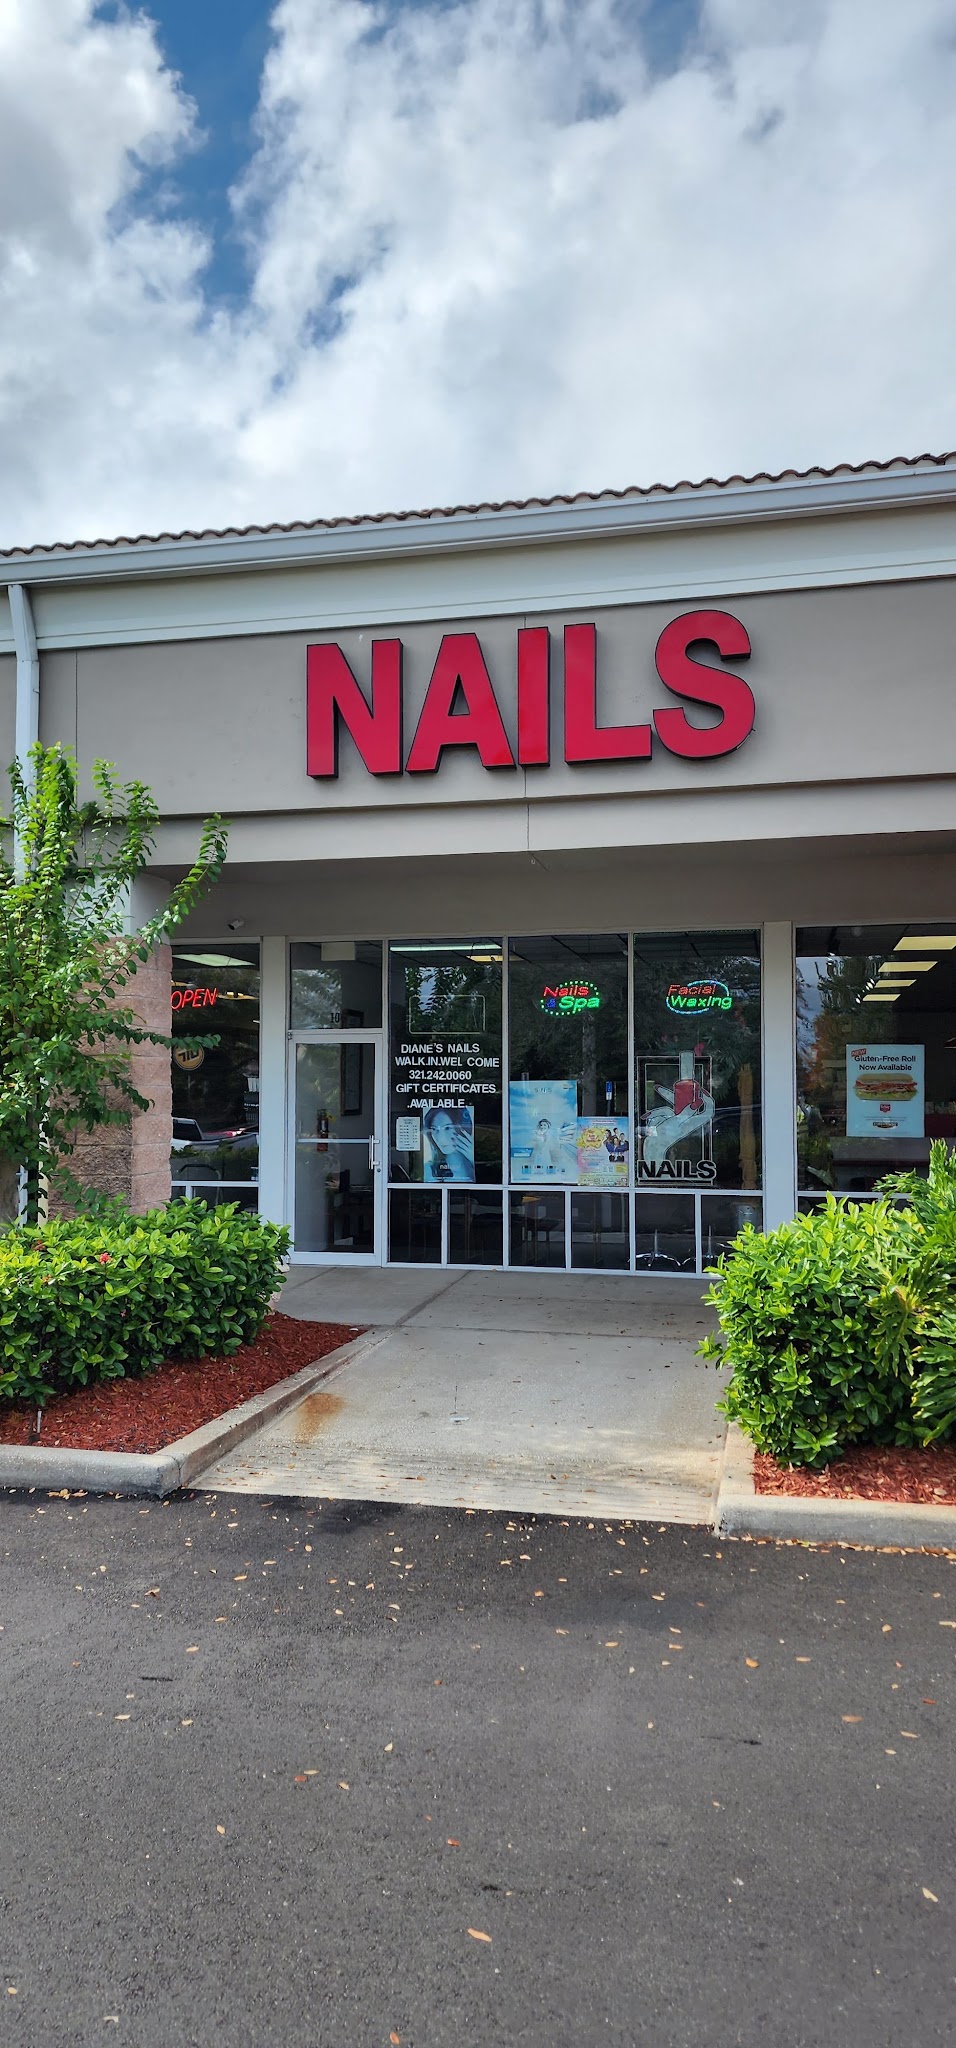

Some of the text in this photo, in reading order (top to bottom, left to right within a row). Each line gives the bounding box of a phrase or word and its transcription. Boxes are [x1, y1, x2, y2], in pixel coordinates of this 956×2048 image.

[306, 609, 756, 778] NAILS
[543, 985, 590, 997] Nails
[667, 984, 716, 996] Facial
[171, 987, 217, 1010] OPEN
[558, 995, 600, 1014] Spa
[669, 994, 733, 1010] Waxing
[401, 1042, 480, 1053] DIANE'S NAILS
[466, 1057, 500, 1068] COME
[878, 1063, 912, 1071] Available
[395, 1083, 496, 1094] GIFT CERTIFICATES
[638, 1160, 716, 1180] NAILS
